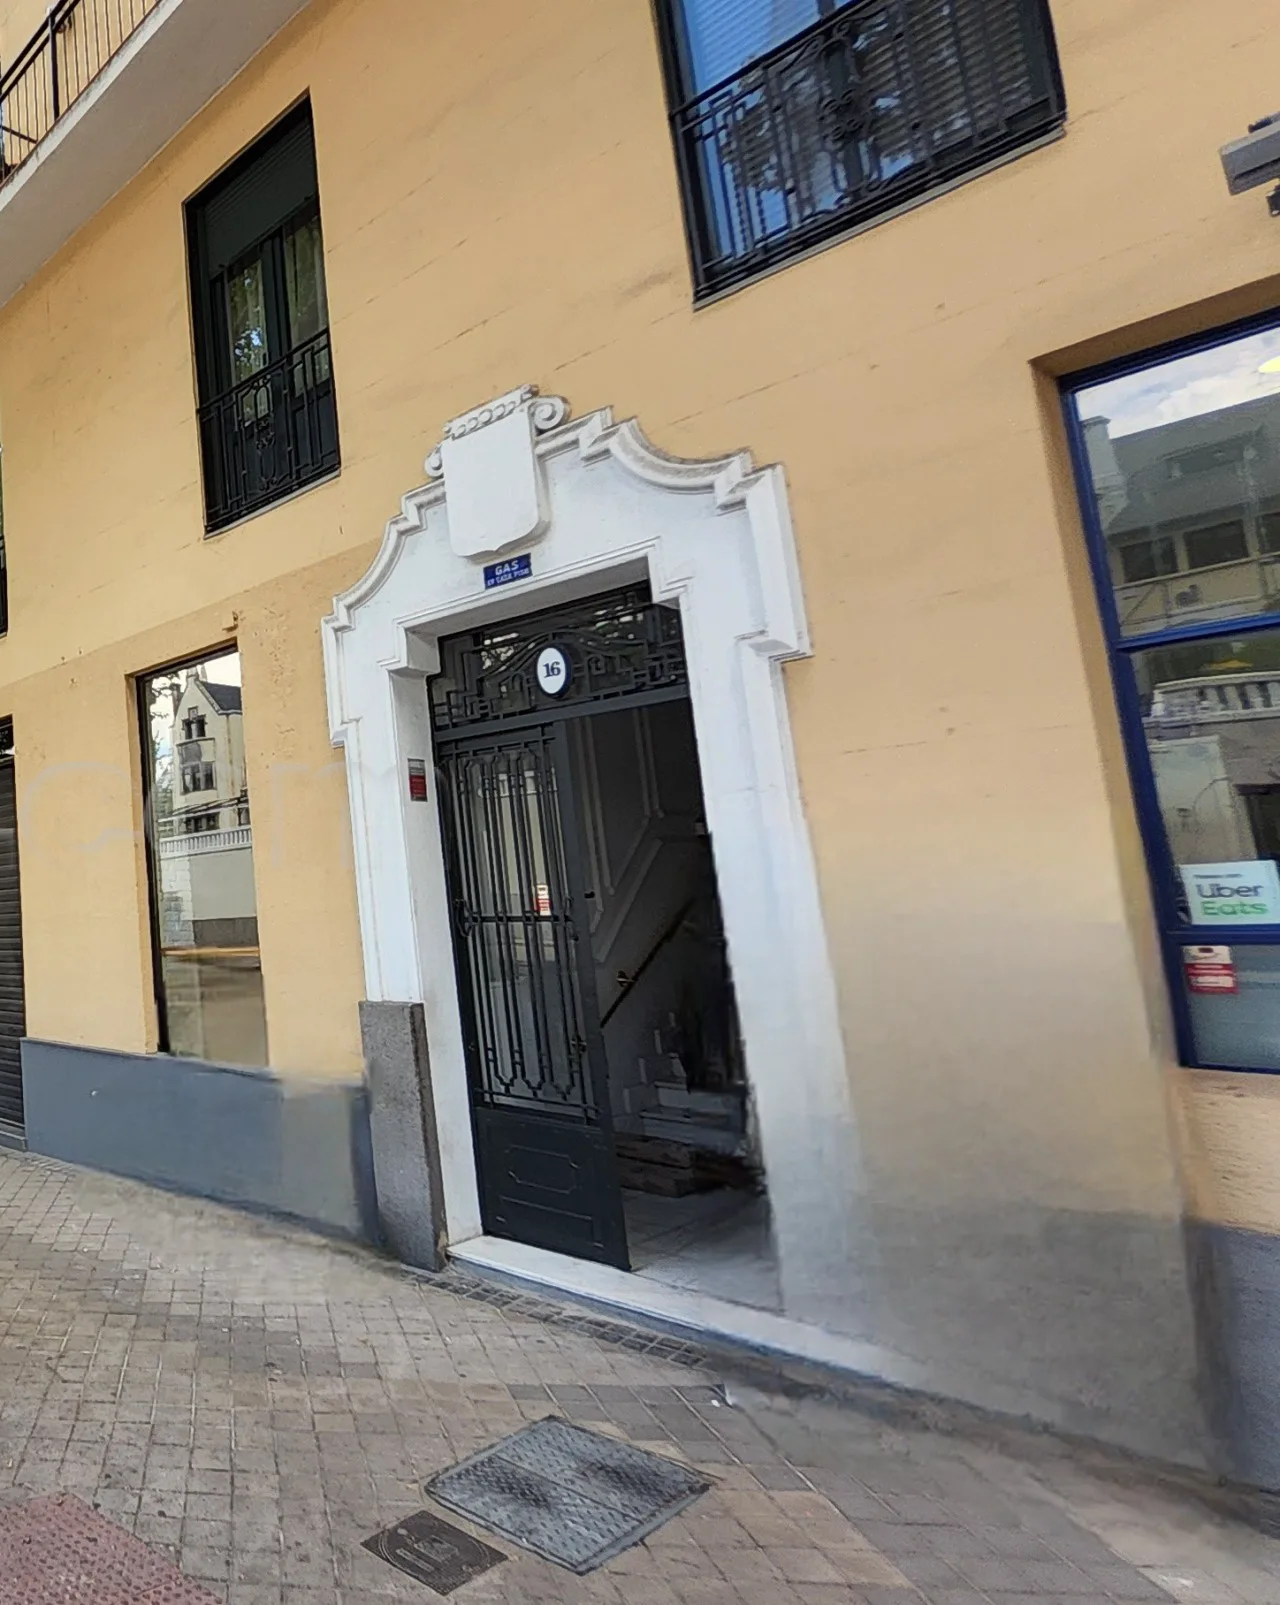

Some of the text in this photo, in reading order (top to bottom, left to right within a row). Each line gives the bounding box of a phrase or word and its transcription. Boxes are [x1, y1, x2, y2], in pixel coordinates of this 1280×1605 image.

[494, 560, 520, 576] GAS
[543, 661, 561, 679] 16
[1195, 883, 1265, 899] Uber
[1201, 901, 1269, 916] Eats
